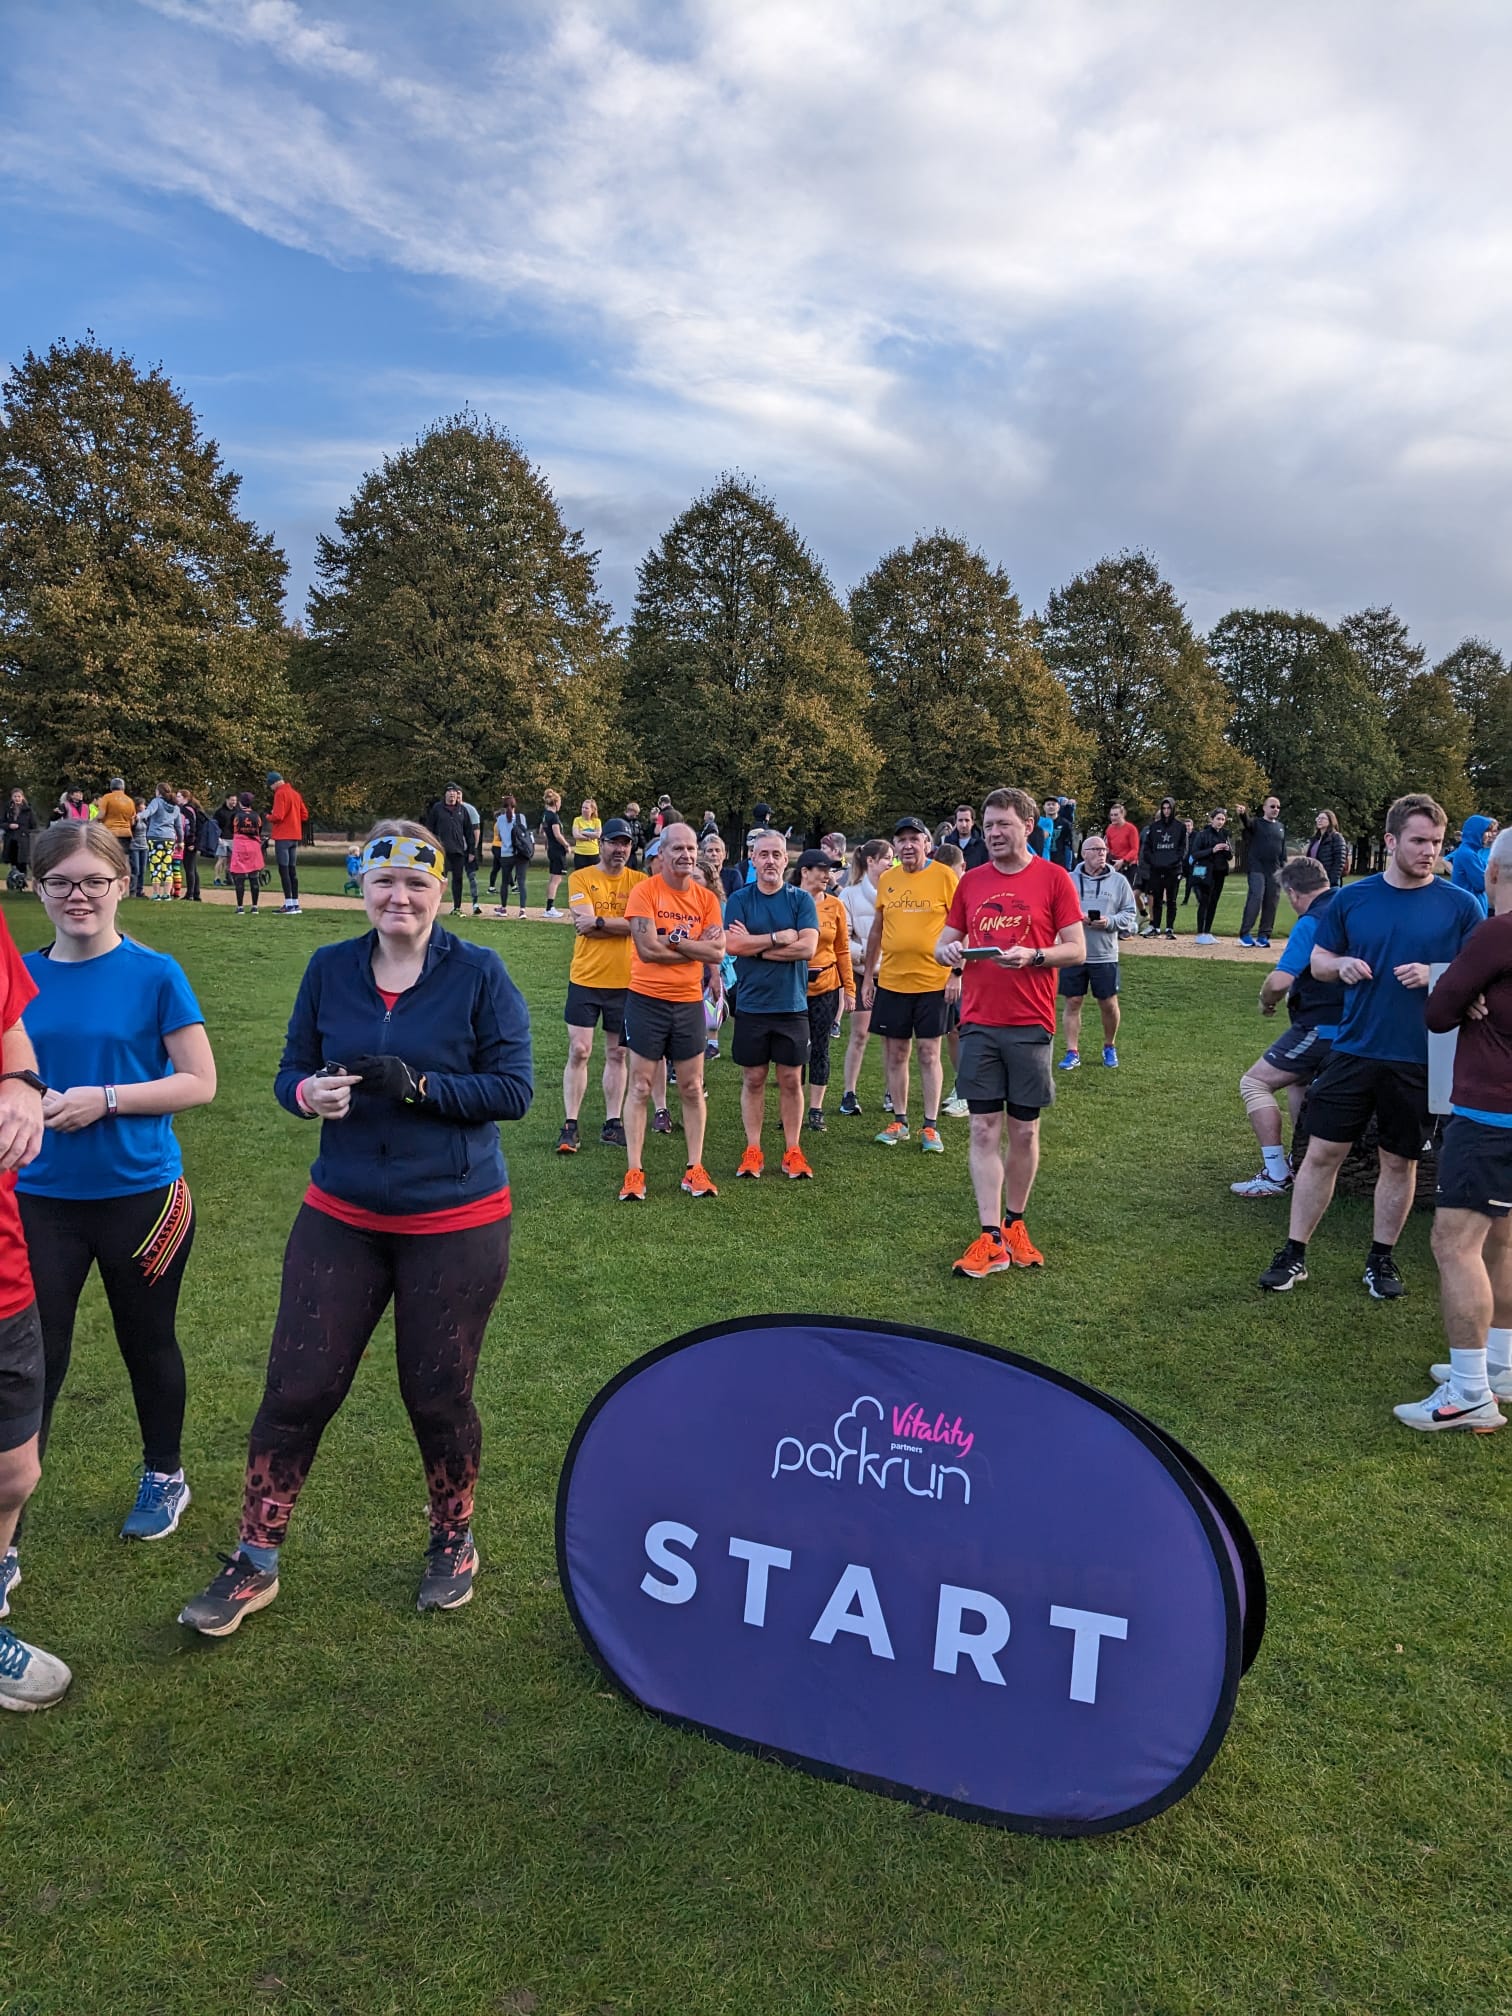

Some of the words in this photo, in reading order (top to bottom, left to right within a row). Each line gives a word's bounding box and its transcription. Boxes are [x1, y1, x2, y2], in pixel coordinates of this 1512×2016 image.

[886, 889, 931, 911] parkrun
[657, 910, 701, 923] CORSHAM
[979, 915, 1023, 932] GNR23
[892, 1402, 975, 1458] Vitality
[771, 1395, 971, 1505] parkrun
[890, 1442, 923, 1454] partners
[640, 1520, 1129, 1704] START
